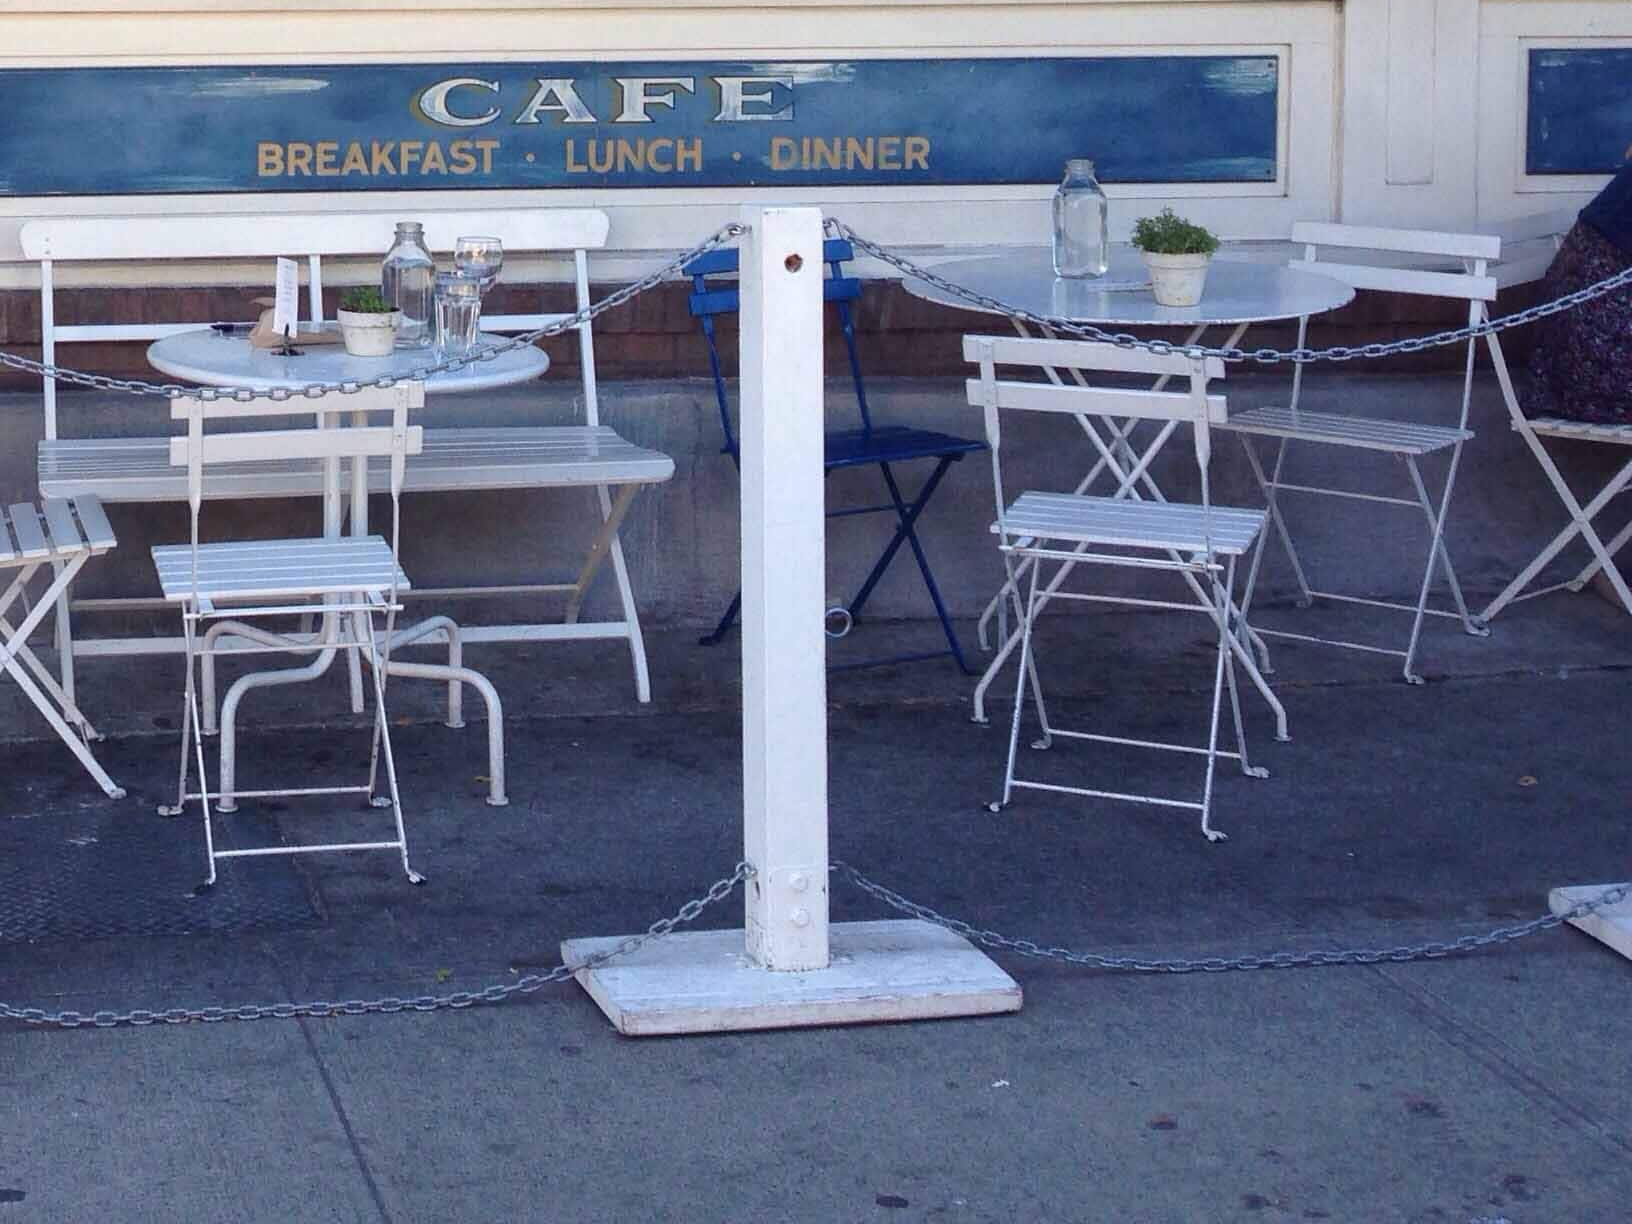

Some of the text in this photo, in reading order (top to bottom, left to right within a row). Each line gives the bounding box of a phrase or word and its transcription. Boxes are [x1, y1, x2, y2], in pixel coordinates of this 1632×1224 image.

[412, 75, 796, 128] CAFE
[256, 135, 931, 177] BREAKFAST LUNCH DINNER
